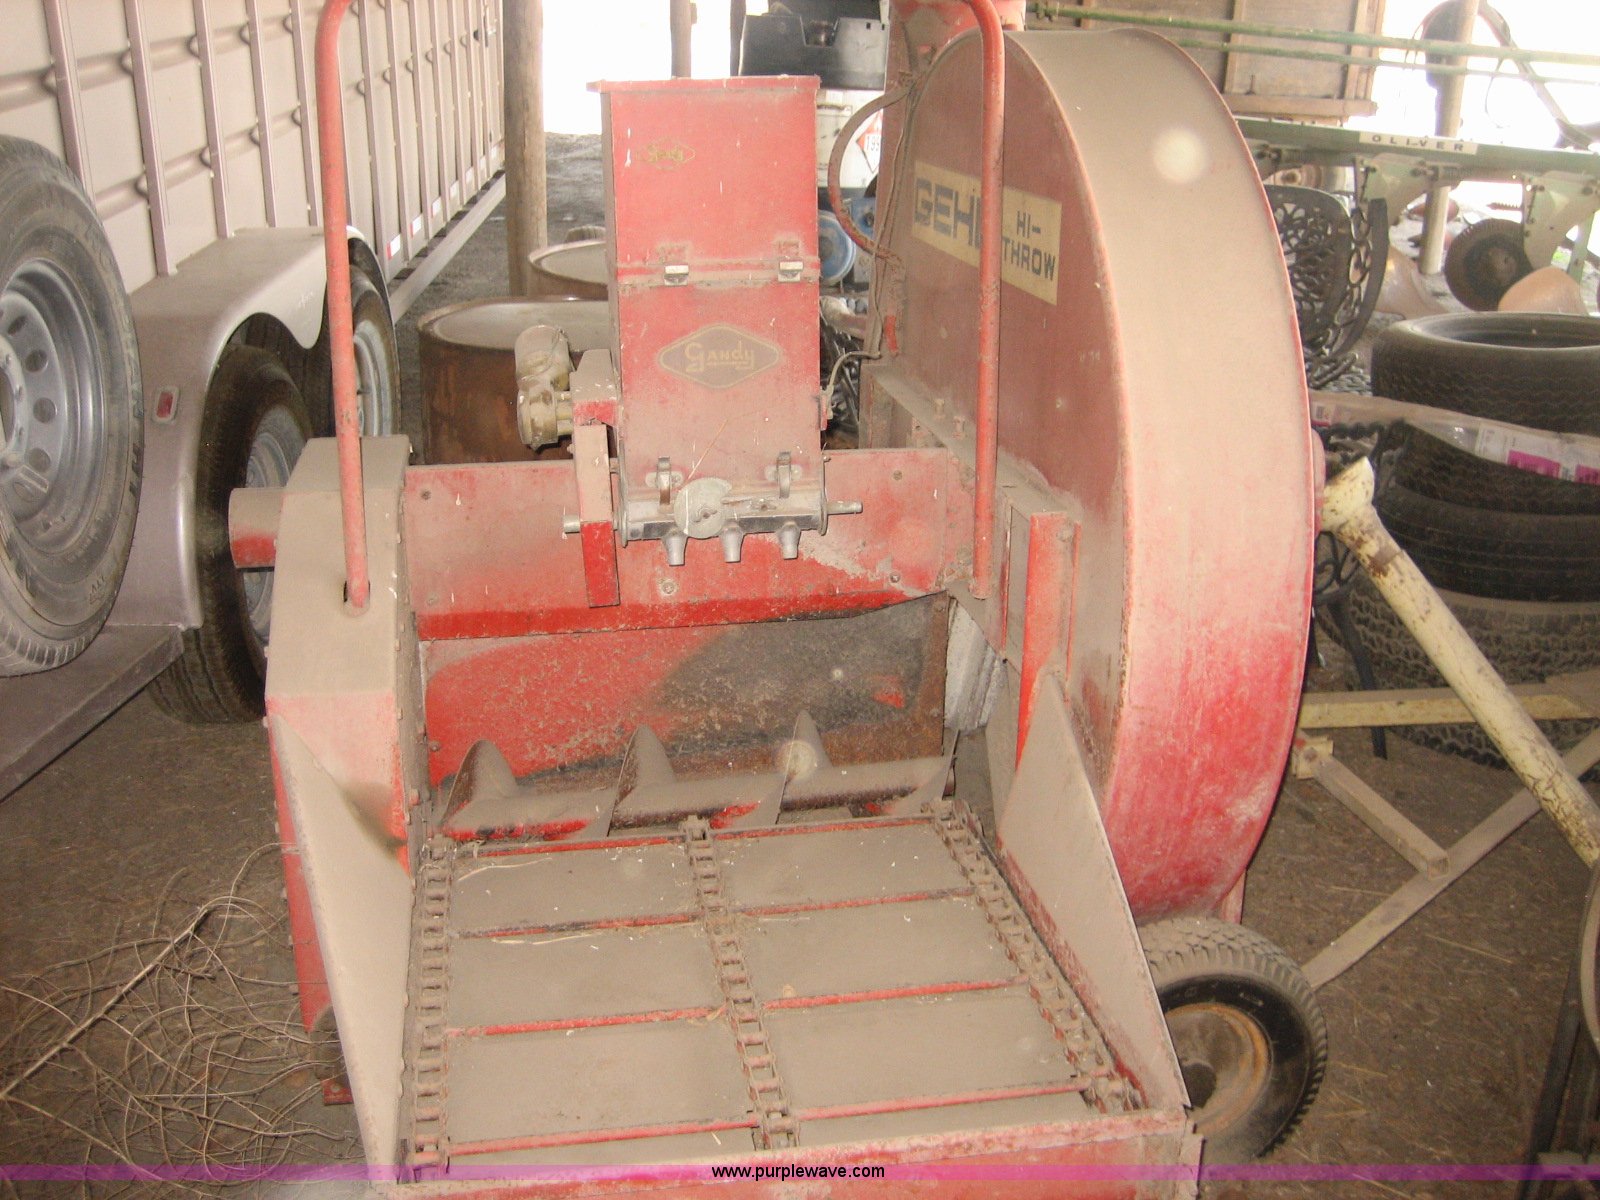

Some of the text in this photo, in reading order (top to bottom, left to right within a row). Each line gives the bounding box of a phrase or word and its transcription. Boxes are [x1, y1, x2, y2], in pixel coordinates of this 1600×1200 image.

[1371, 134, 1464, 151] OLIVER
[1016, 210, 1041, 239] HI-
[1002, 236, 1056, 281] THROW
